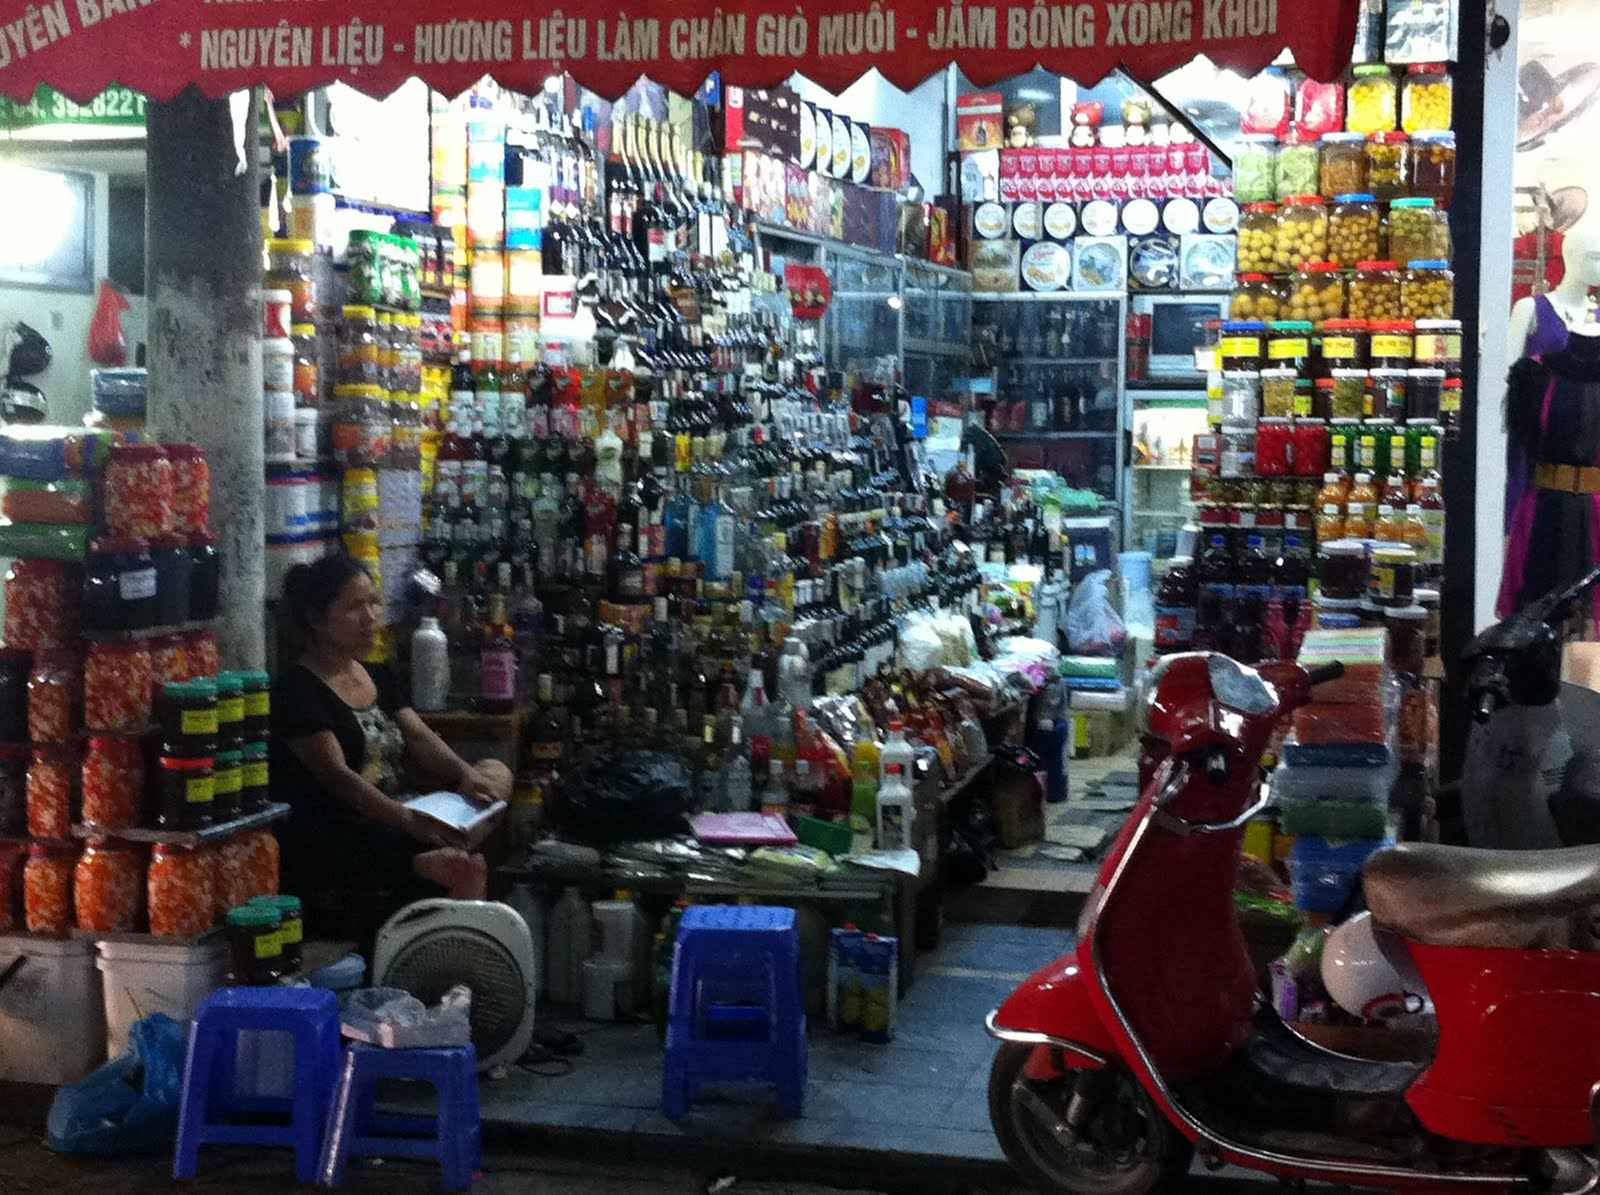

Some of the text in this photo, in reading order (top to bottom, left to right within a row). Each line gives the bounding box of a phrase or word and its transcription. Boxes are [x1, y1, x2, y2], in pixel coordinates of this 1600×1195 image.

[201, 18, 313, 69] NGUYÊN
[321, 16, 385, 74] LIỆU
[522, 9, 587, 68] LIỆU
[597, 10, 660, 60] LÀM
[669, 7, 746, 60] CHÂN
